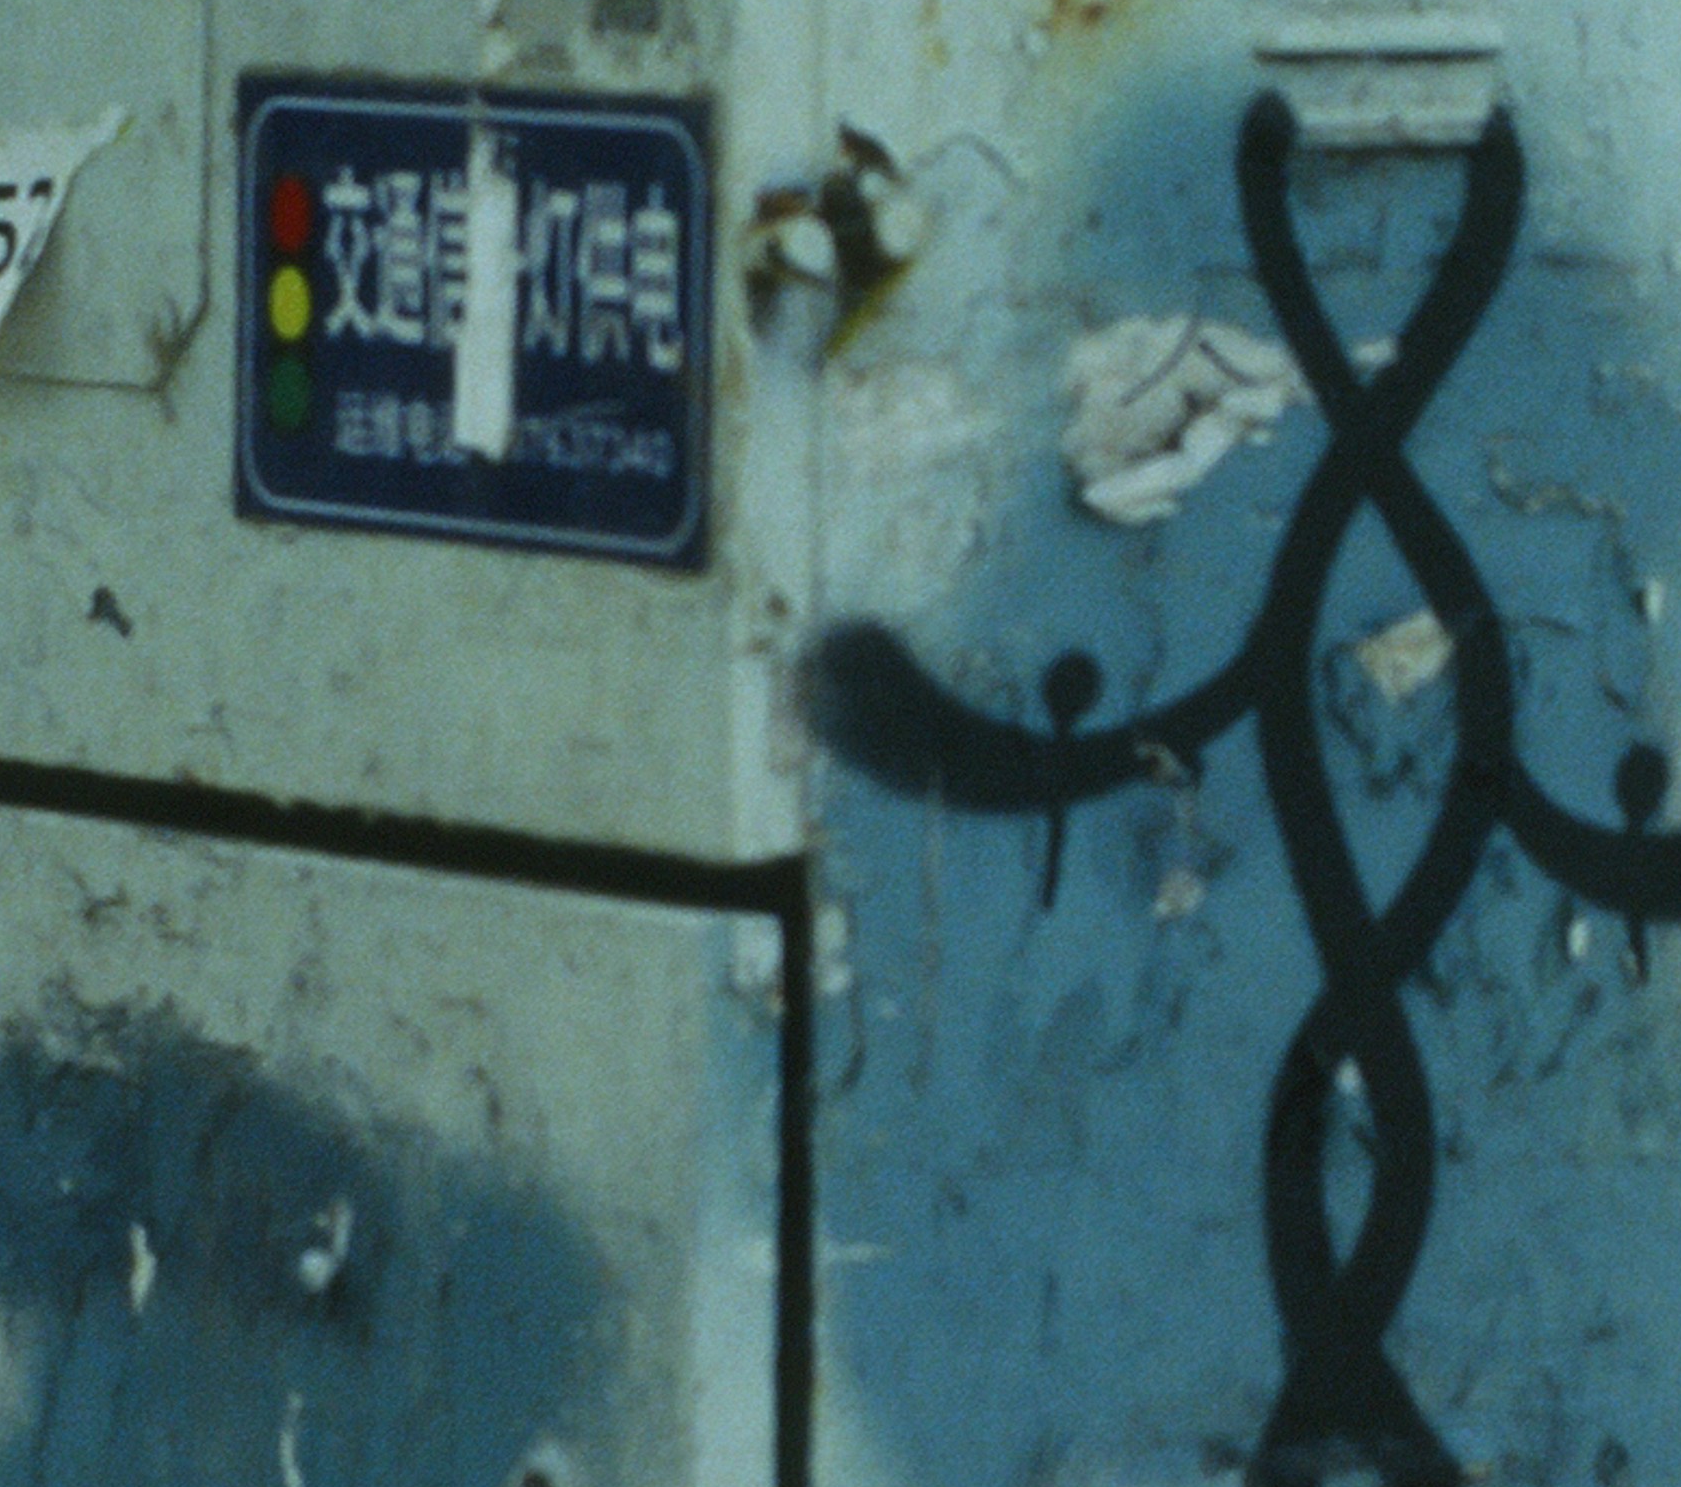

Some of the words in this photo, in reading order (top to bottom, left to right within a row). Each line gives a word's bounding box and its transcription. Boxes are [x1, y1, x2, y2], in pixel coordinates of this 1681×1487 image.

[322, 162, 684, 372] 交通信灯供电
